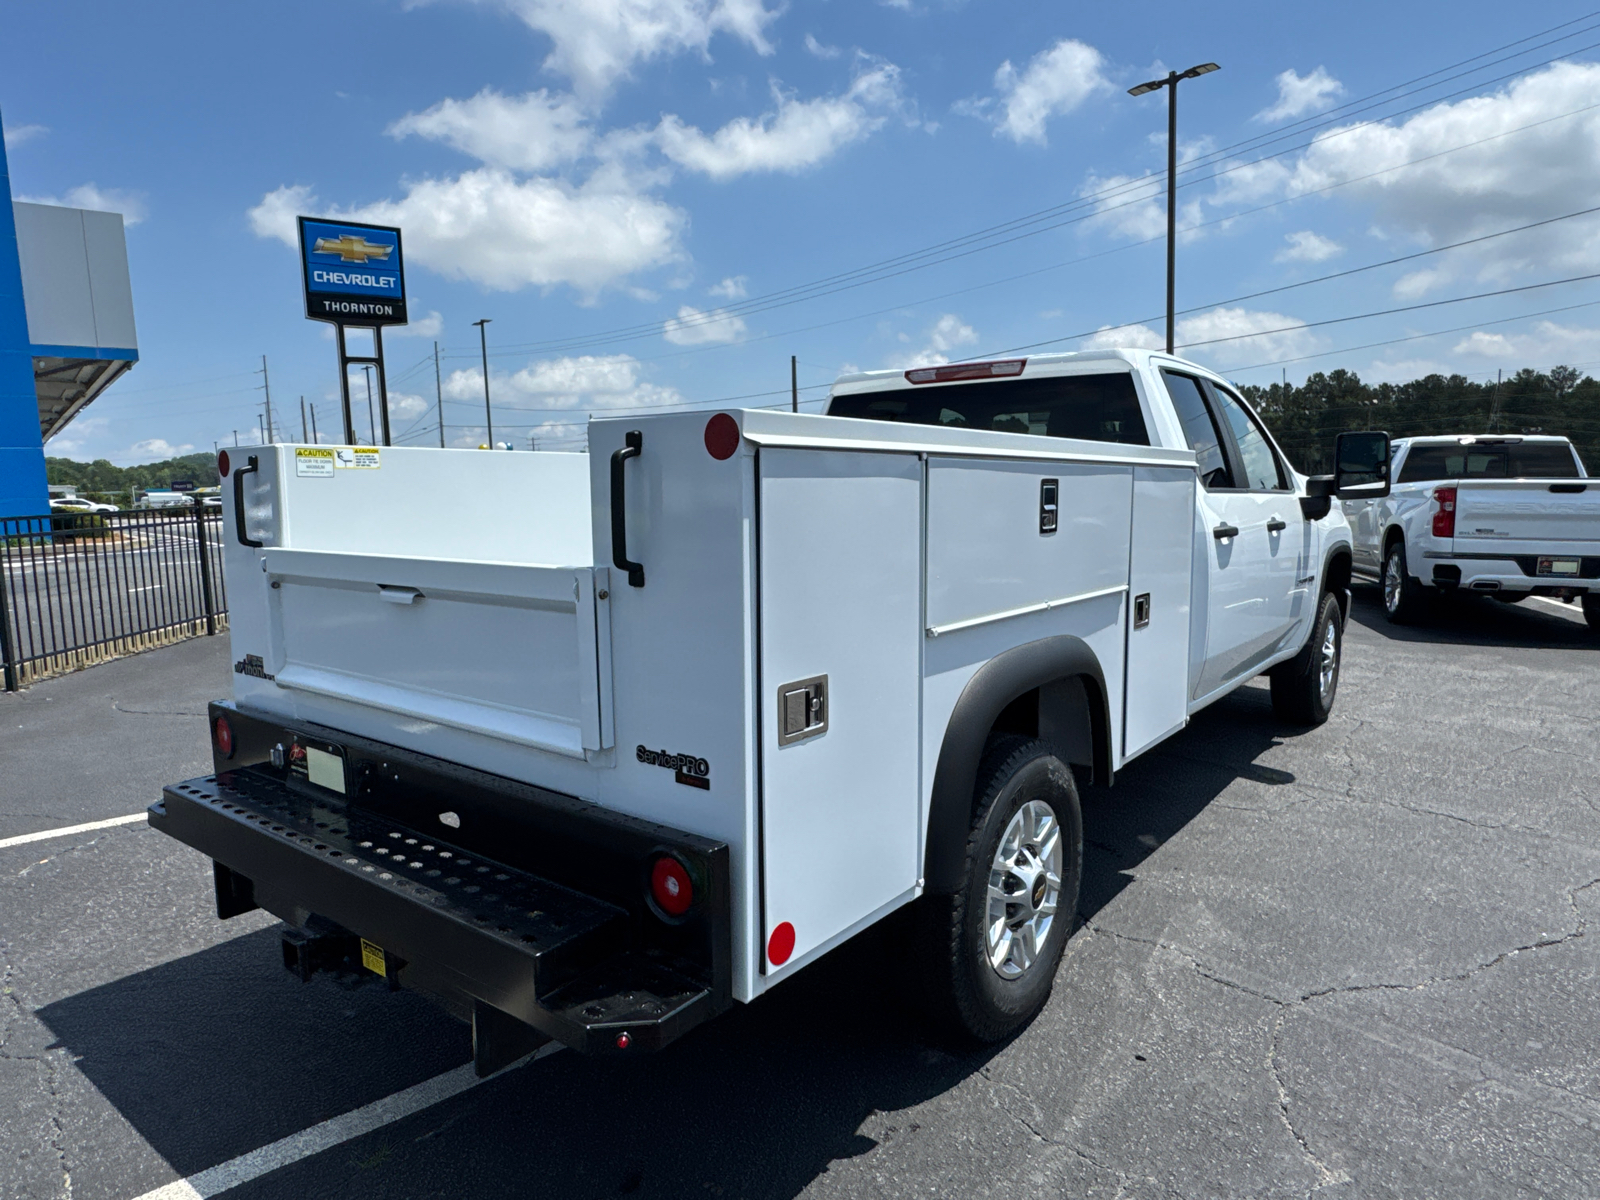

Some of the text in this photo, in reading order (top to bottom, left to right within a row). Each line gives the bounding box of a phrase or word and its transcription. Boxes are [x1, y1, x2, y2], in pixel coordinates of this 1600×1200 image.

[313, 270, 396, 288] CHEVROLET
[323, 301, 393, 315] THORNTON
[302, 449, 332, 457] CAUTION
[636, 745, 709, 776] ServicePRO
